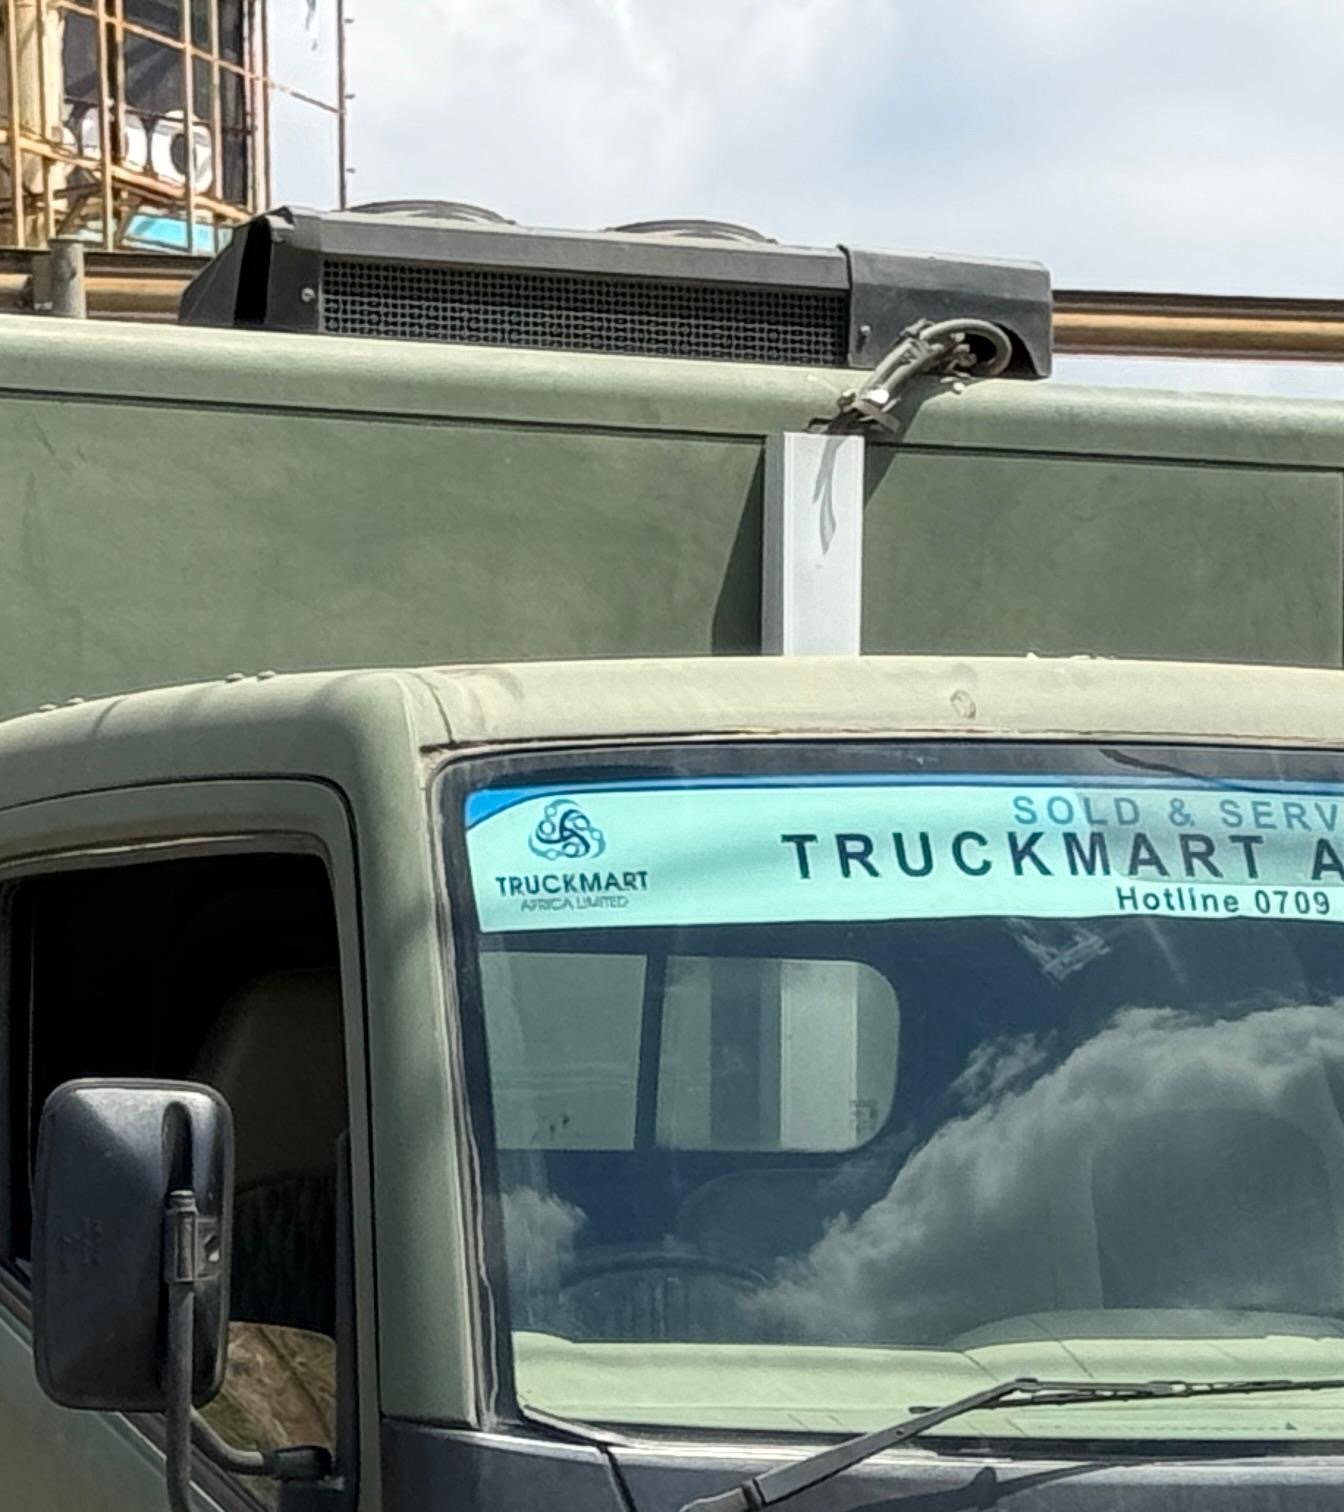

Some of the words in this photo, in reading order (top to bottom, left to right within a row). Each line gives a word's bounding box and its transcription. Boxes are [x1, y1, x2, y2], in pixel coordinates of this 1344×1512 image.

[1012, 795, 1140, 826] SOLD
[1169, 798, 1196, 827] &
[780, 830, 1265, 880] TRUCKMART
[495, 871, 648, 896] TRUCKMART
[1115, 886, 1240, 914] Hotline
[1255, 890, 1331, 915] 0709
